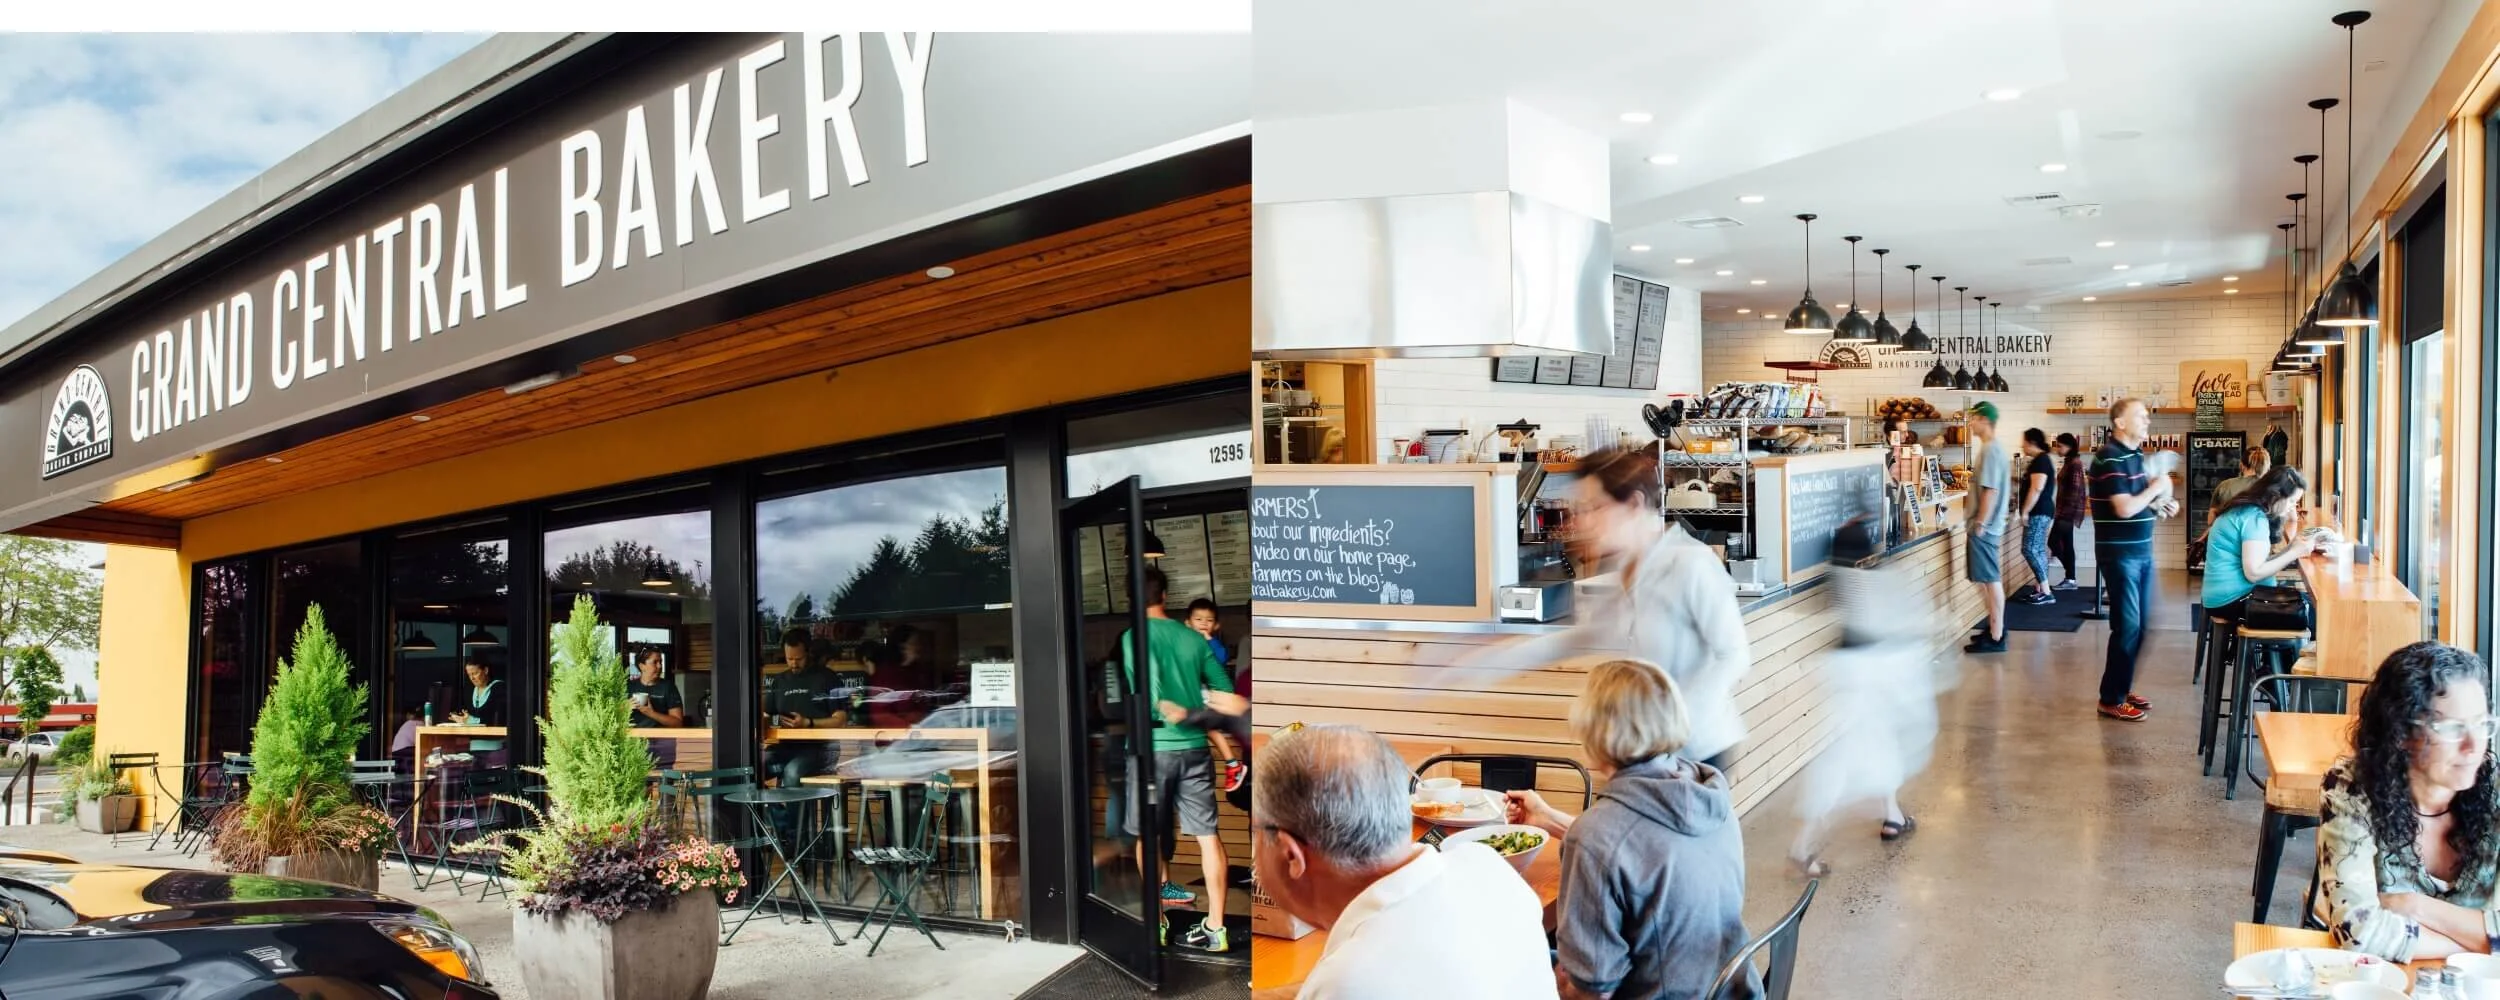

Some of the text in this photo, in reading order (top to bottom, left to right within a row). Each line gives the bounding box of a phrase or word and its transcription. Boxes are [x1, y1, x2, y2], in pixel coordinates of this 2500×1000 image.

[129, 31, 936, 443] GRAND CENTRAL BAKERY
[1930, 335, 1992, 354] CENTRAL
[1997, 334, 2053, 353] BAKERY
[1878, 360, 1910, 369] BAKING
[1209, 443, 1244, 464] 12595
[1283, 524, 1305, 541] our
[1308, 517, 1395, 549] ingredients?
[1254, 541, 1417, 575] video on our home page,
[1252, 561, 1302, 583] farmers
[1305, 569, 1323, 582] on
[1324, 566, 1346, 586] the
